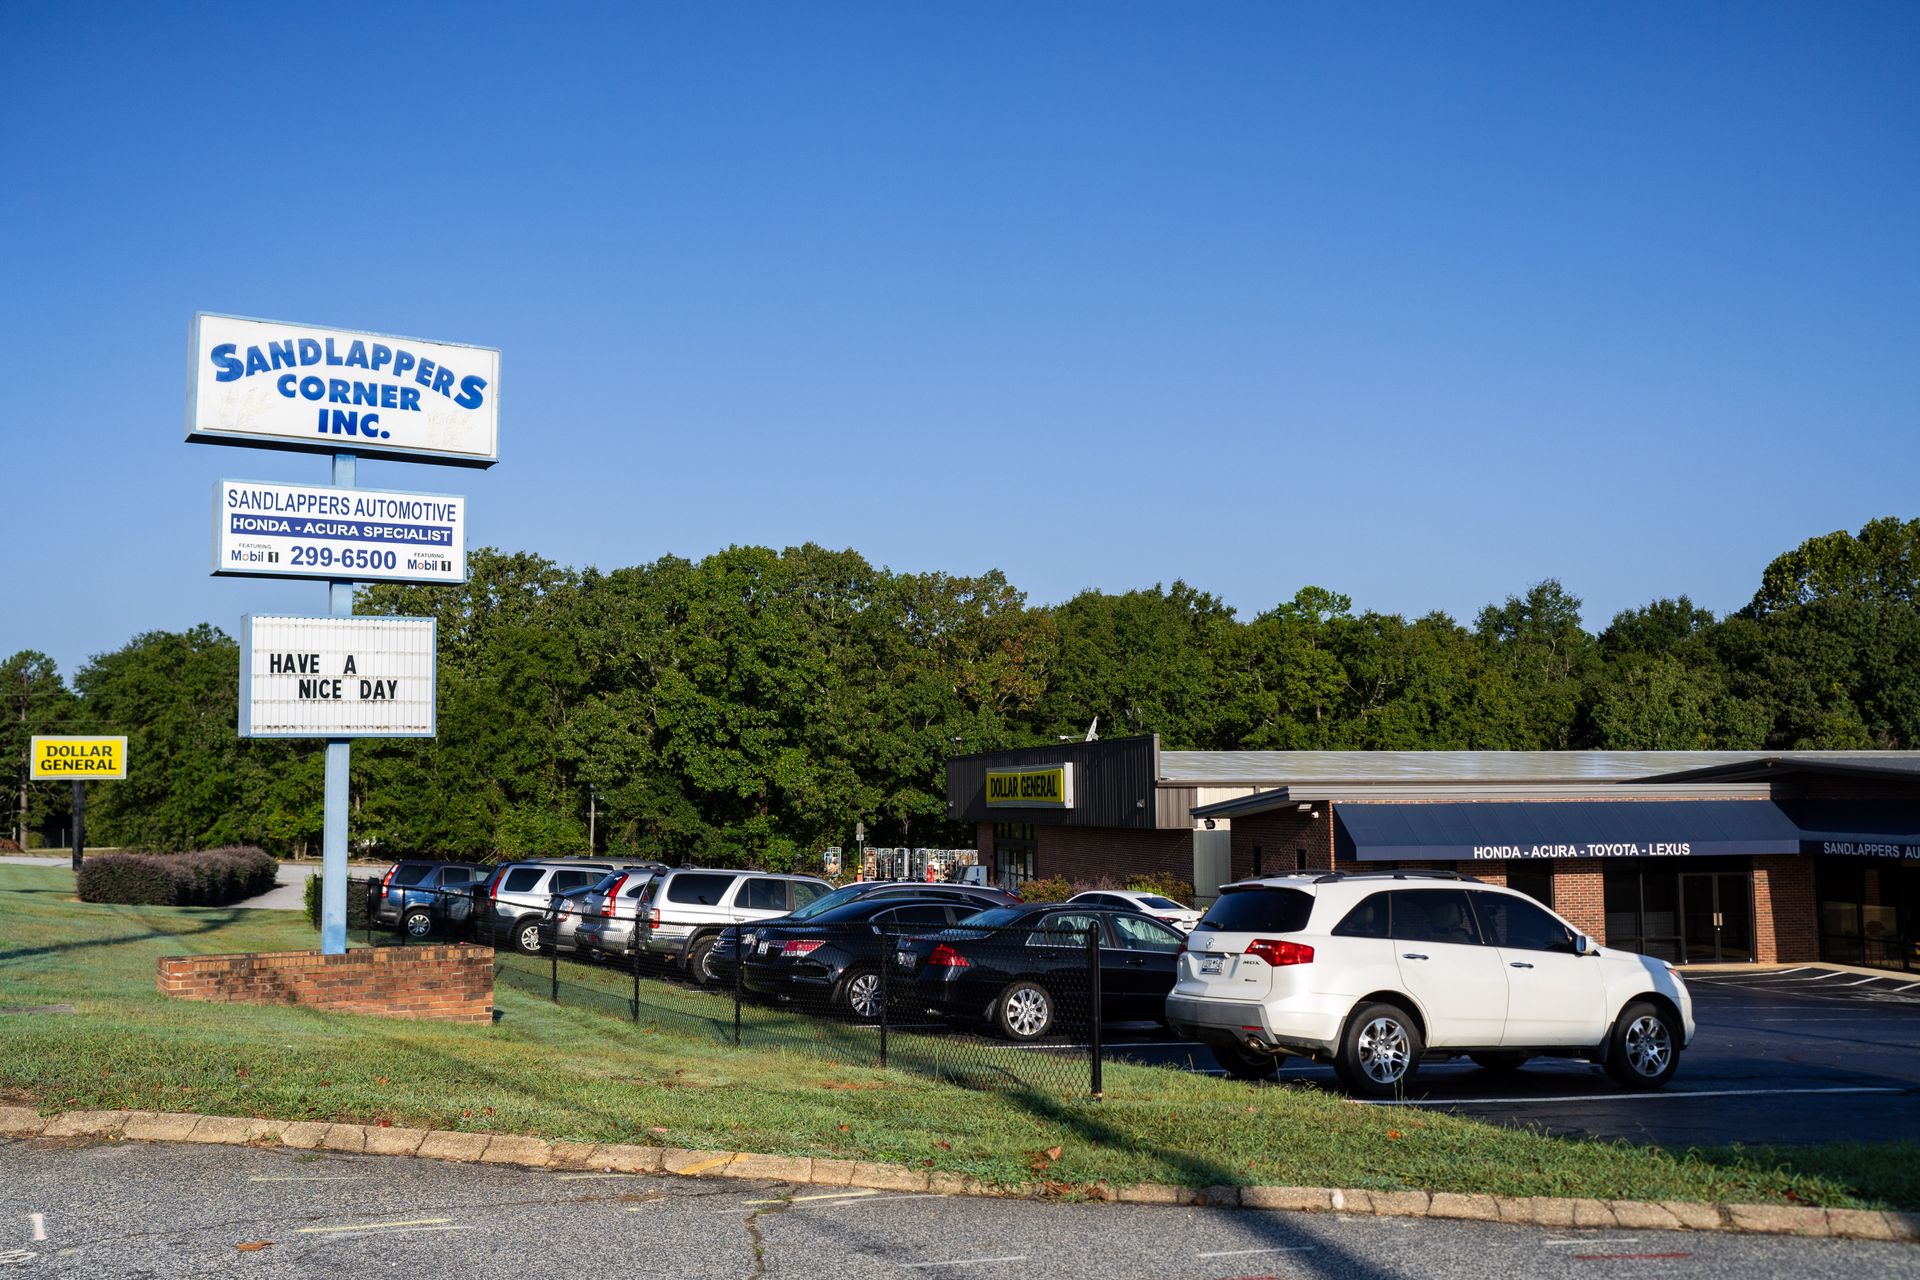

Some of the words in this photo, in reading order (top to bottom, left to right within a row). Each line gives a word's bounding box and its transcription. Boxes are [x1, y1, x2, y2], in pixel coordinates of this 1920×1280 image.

[210, 337, 488, 410] SANDLAPPERS
[276, 373, 422, 412] CORNER
[317, 408, 391, 440] INC.
[228, 488, 350, 516] SANDLAPPERS
[354, 498, 457, 523] AUTOMOTIVE
[232, 517, 291, 533] HONDA
[303, 522, 359, 537] ACURA
[363, 526, 451, 542] SPECIALIST
[231, 549, 264, 563] Mobil
[290, 545, 397, 570] 299-6500
[407, 559, 437, 571] Mobil
[270, 653, 320, 674] HAVE
[343, 654, 357, 675] A
[299, 679, 342, 698] NICE
[360, 680, 398, 700] DAY
[46, 746, 112, 756] DOLLAR
[41, 759, 116, 770] GENERAL
[990, 777, 1018, 797] DOLLAR
[1021, 775, 1057, 797] GENERAL
[1474, 846, 1521, 860] HONDA
[1531, 845, 1577, 858] ACURA
[1587, 844, 1639, 857] TOYOTA
[1648, 843, 1691, 856] LEXUS
[1824, 842, 1899, 858] SANDLAPPERS
[1904, 846, 1920, 859] AU
